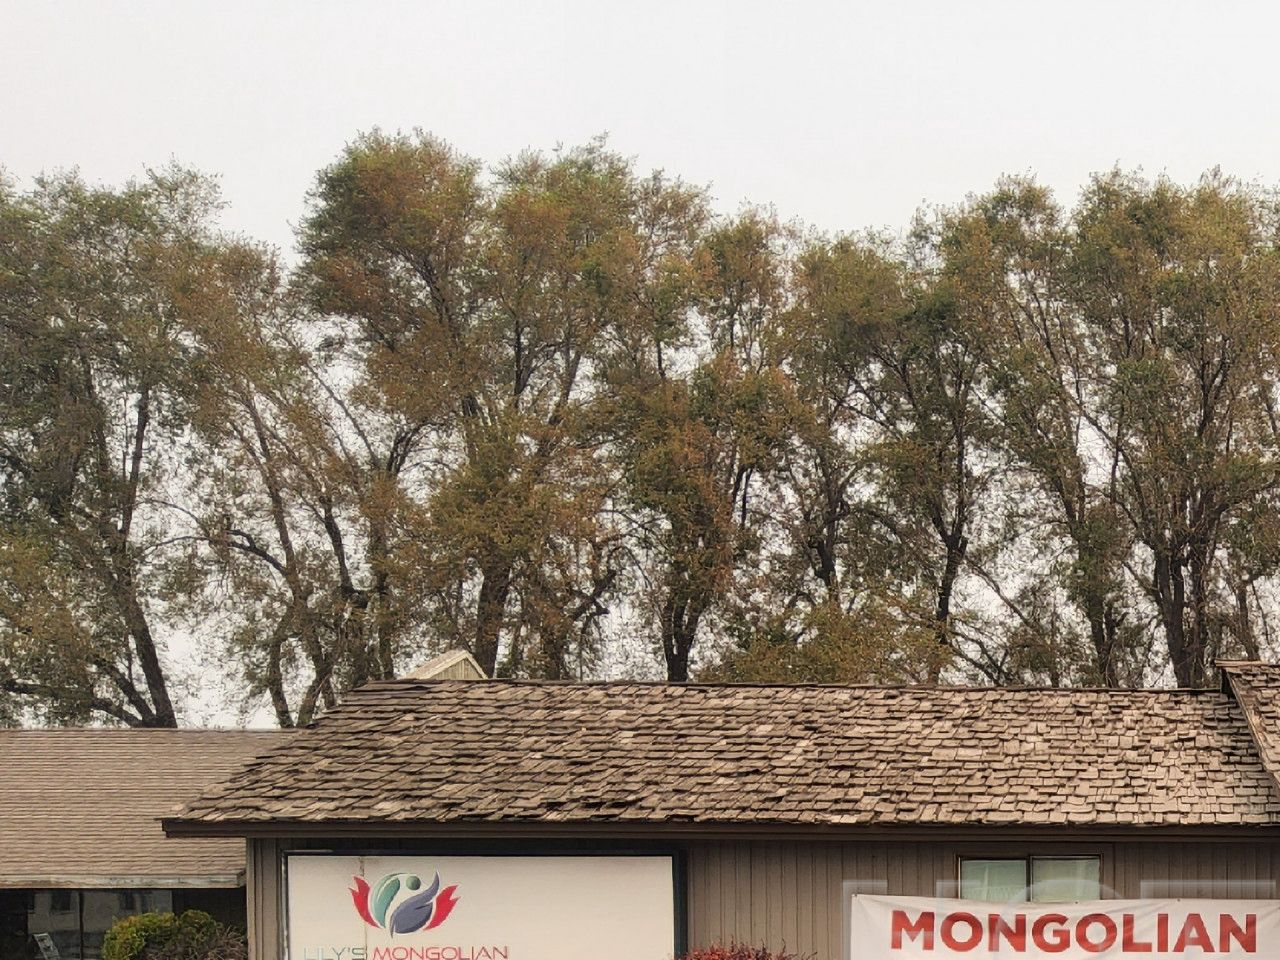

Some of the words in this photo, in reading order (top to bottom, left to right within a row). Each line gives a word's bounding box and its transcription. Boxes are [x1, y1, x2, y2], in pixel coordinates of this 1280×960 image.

[890, 909, 1258, 953] MONGOLIAN
[303, 945, 367, 960] LILY'S
[371, 945, 510, 960] MONGOLIAN
